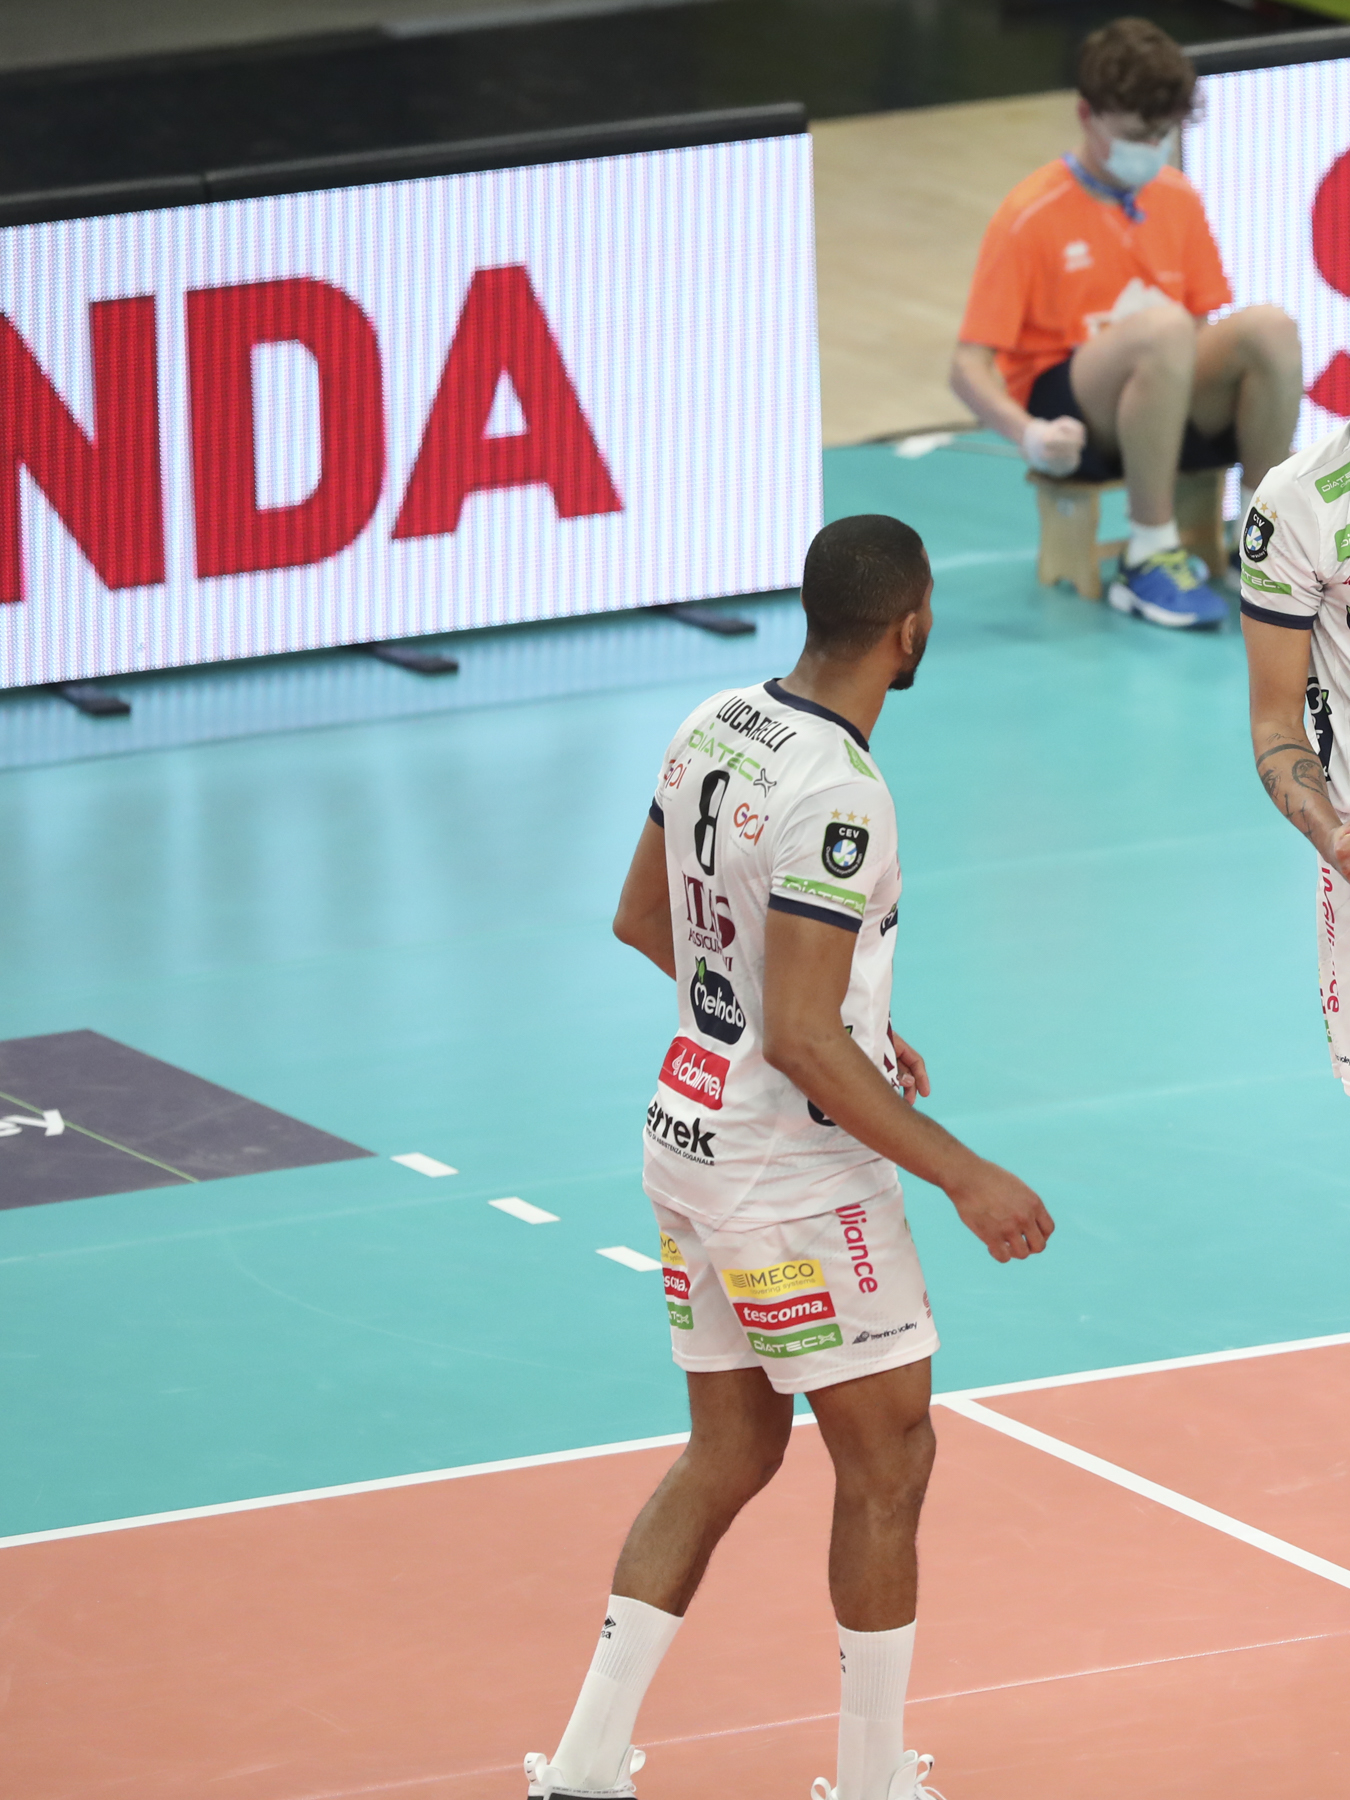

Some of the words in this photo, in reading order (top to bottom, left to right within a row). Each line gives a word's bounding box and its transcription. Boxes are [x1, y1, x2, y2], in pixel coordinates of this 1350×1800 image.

[716, 696, 797, 752] LUCARELLI
[694, 769, 730, 876] 8
[838, 827, 860, 839] CEV
[743, 1299, 824, 1324] tescoma
